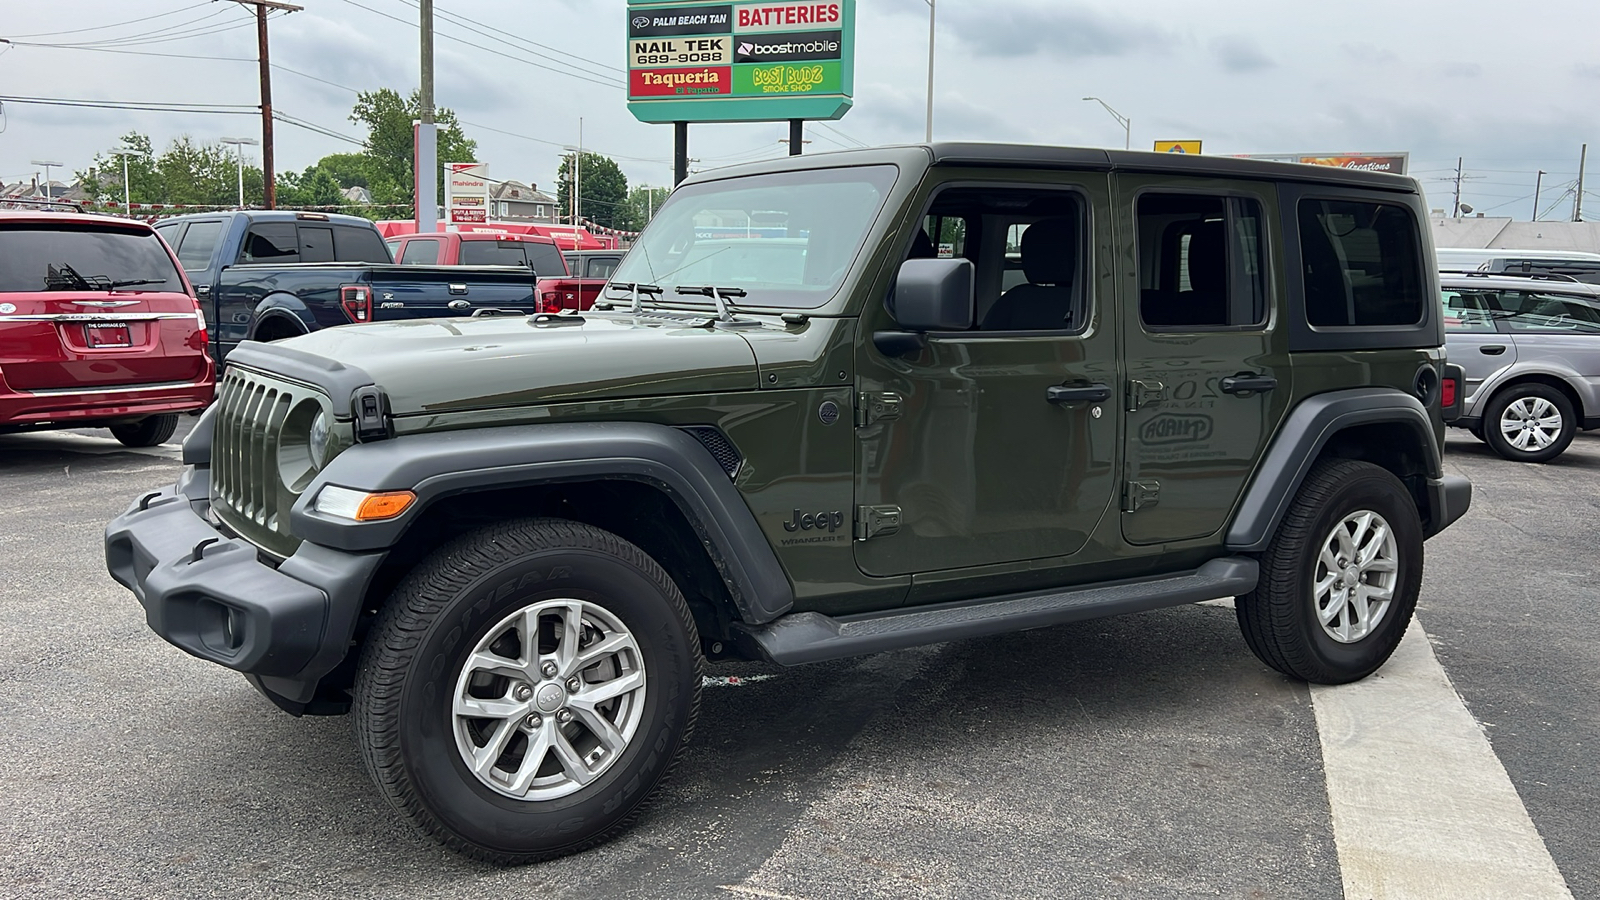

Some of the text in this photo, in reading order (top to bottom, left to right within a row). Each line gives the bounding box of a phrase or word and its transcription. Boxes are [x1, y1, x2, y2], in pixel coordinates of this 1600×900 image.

[652, 13, 727, 27] PALM BEACH TAN
[738, 4, 839, 27] BATTERIES
[635, 38, 724, 54] NAIL TEK
[637, 52, 722, 65] 689-9088
[786, 65, 824, 85] BUDZ
[762, 84, 812, 93] SMOKE SHOP
[783, 508, 844, 533] Jeep
[780, 536, 836, 545] WRANGLER
[540, 691, 560, 705] Jeep
